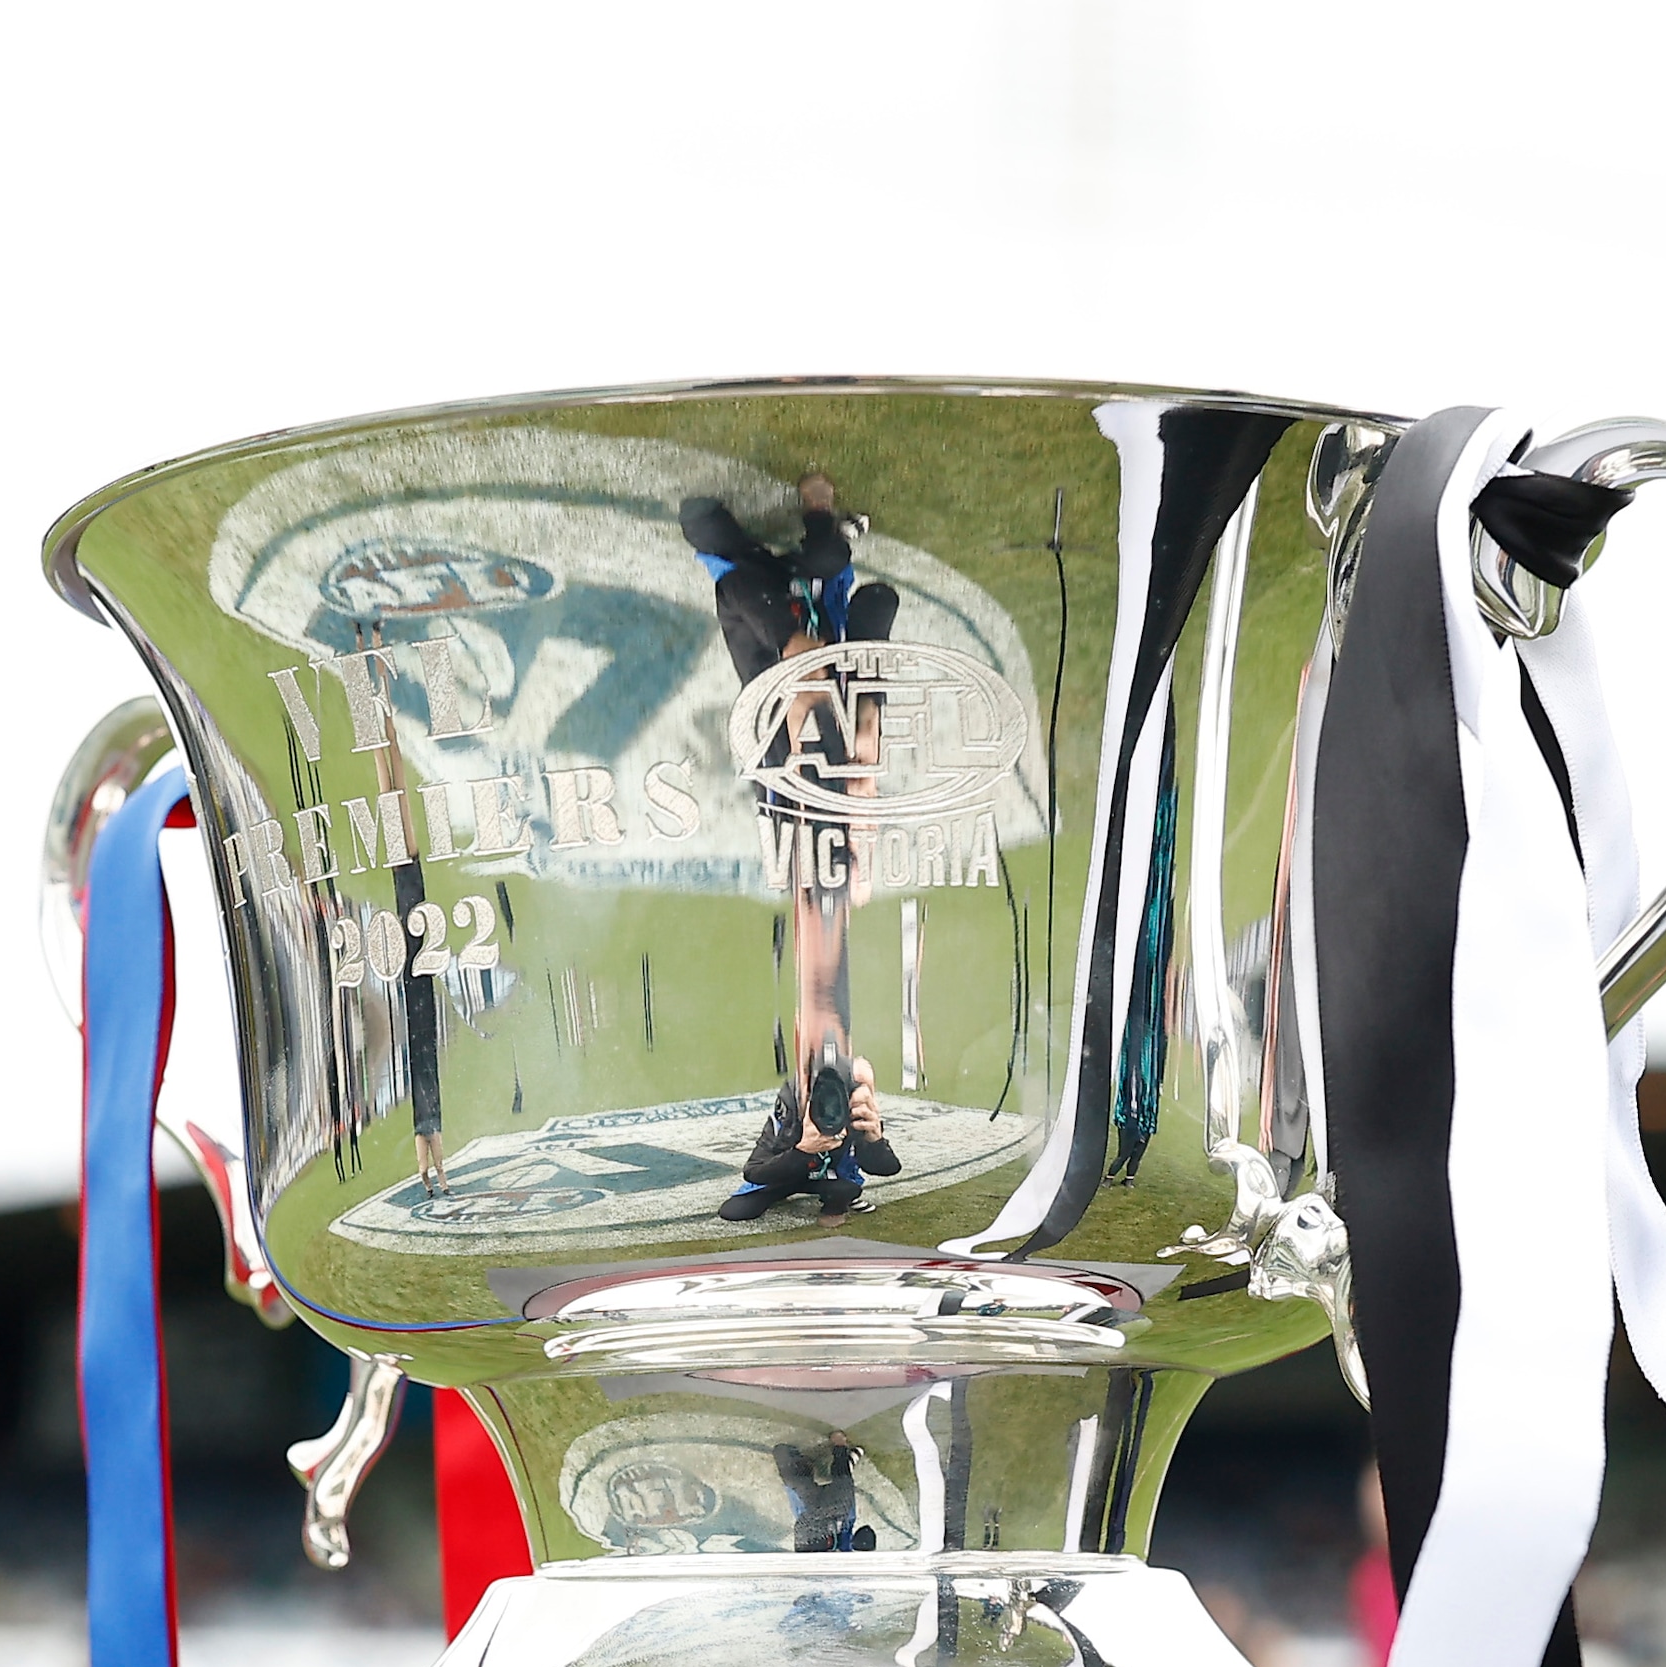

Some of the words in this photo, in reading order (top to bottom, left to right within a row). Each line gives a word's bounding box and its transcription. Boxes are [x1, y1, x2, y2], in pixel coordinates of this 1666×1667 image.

[267, 634, 494, 762] VFL
[741, 678, 1005, 780] AFL
[222, 756, 702, 909] PREMIERS
[755, 811, 1000, 889] VICTORIA
[333, 895, 500, 988] 2022
